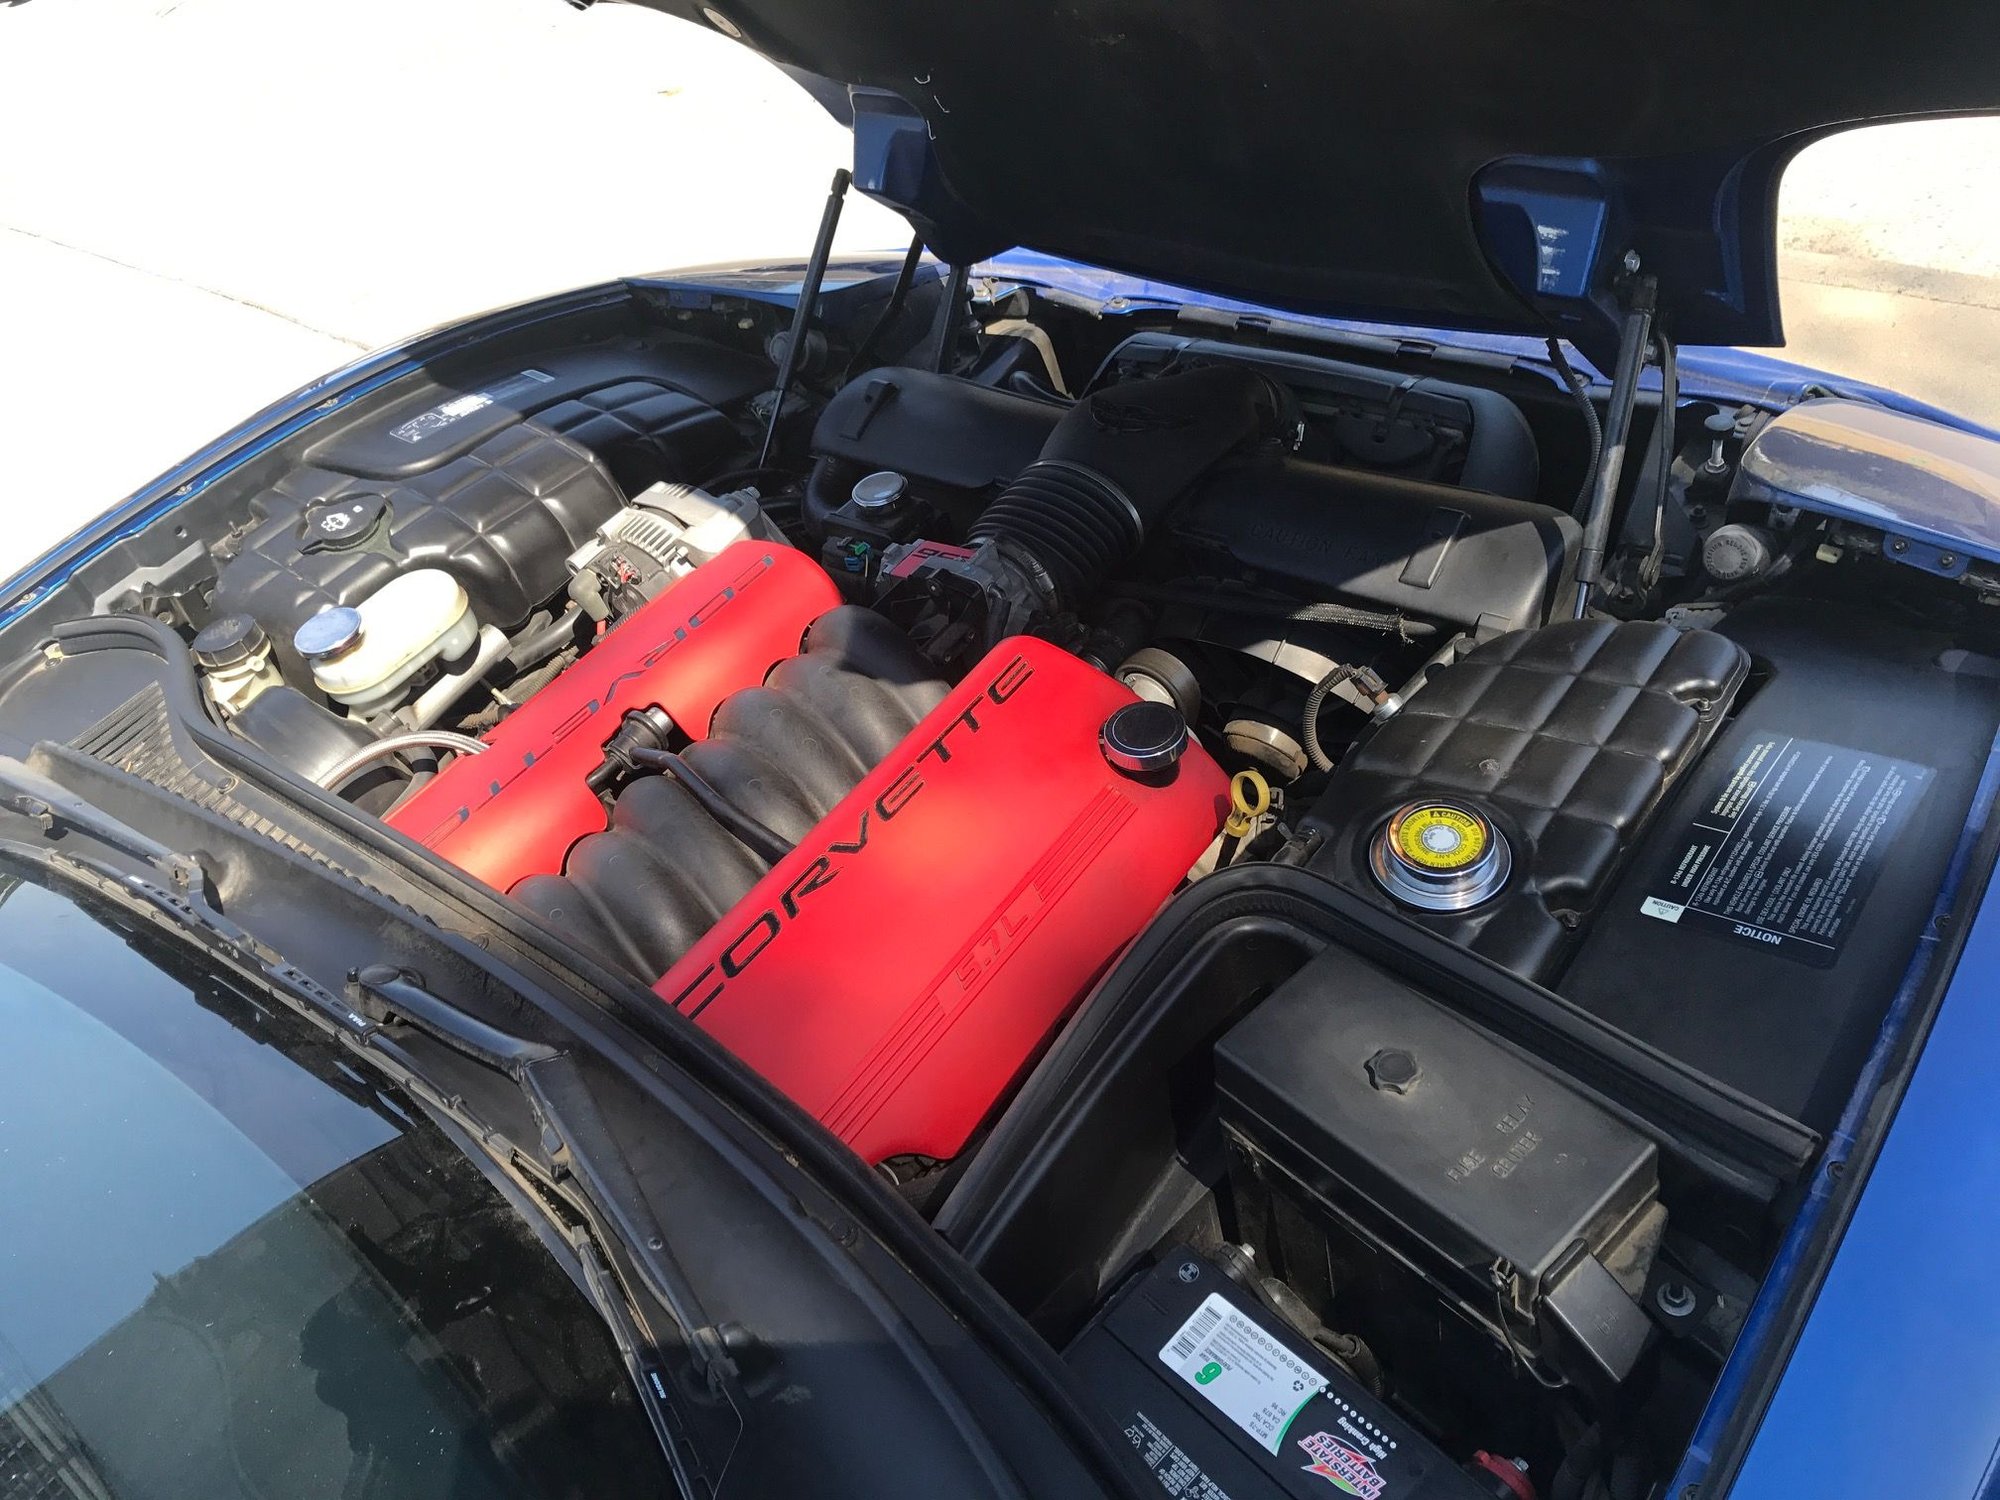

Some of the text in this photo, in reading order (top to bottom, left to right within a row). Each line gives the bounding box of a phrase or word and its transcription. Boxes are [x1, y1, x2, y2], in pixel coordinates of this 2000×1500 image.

[1441, 810, 1471, 827] CAUTION
[671, 654, 1036, 1020] CORVETTE
[1651, 899, 1680, 911] CAUTION
[1732, 924, 1783, 944] NOTICE
[1446, 1150, 1485, 1183] FUSE
[1195, 1362, 1222, 1385] 6
[1305, 1437, 1376, 1499] INTERSTATE
[1317, 1435, 1380, 1486] BATTERIES
